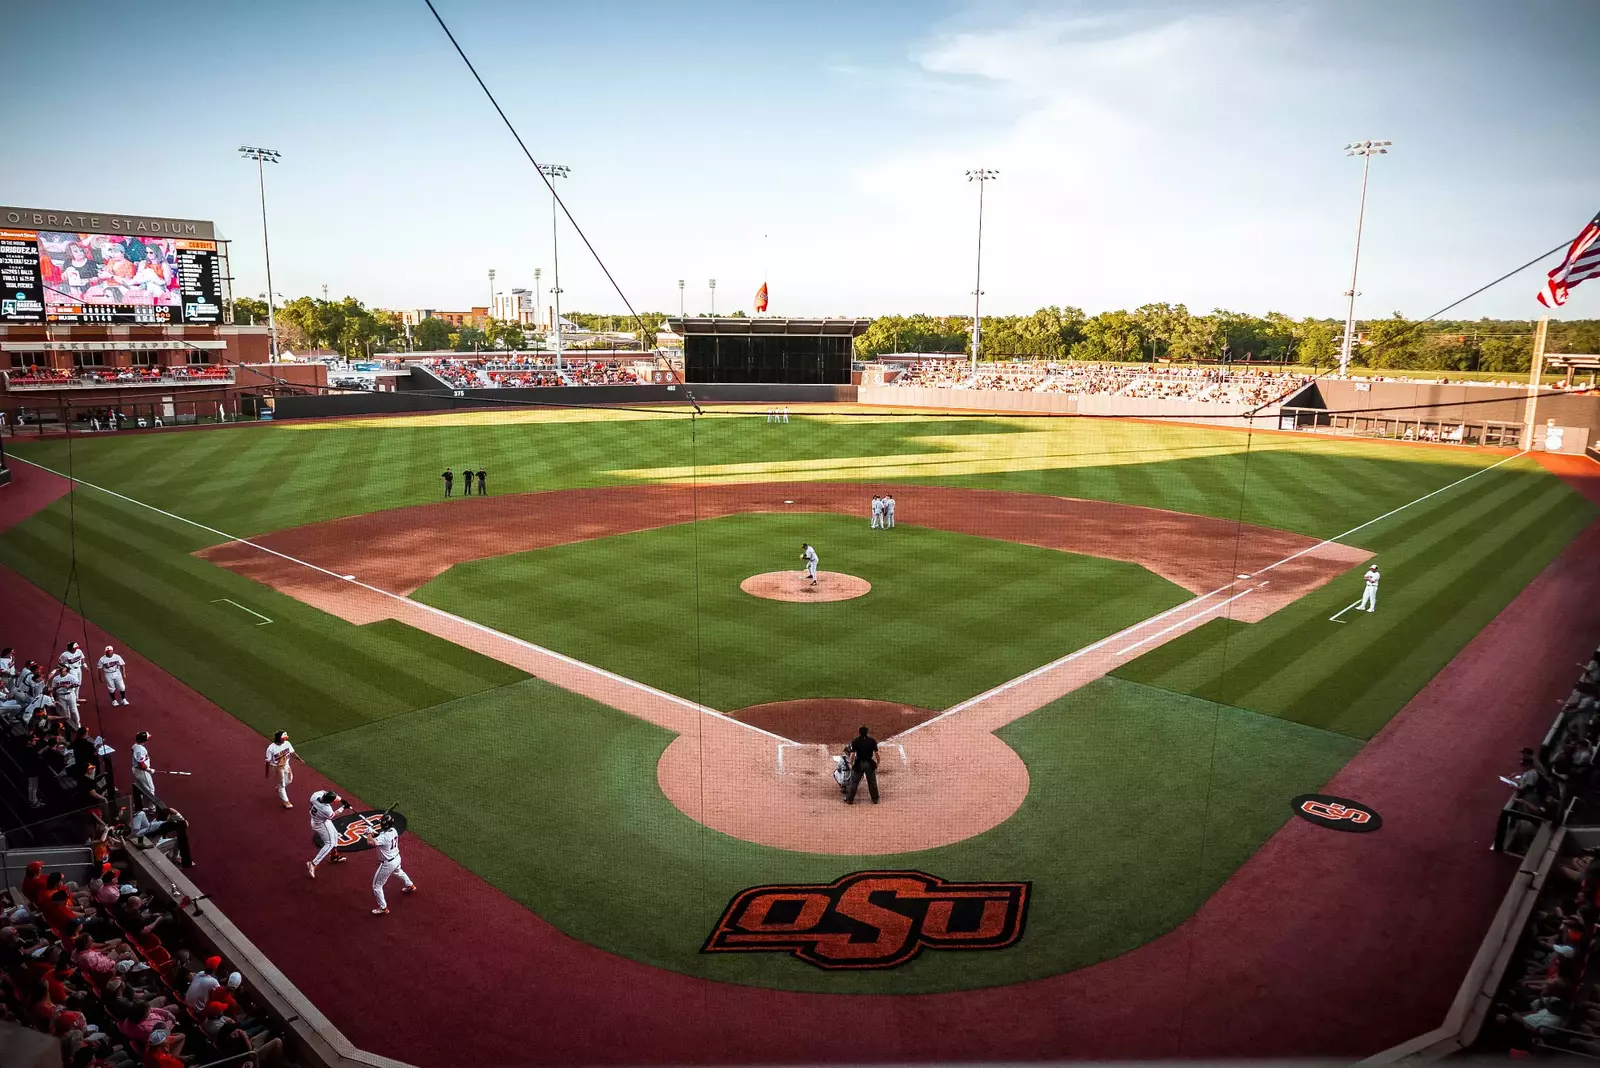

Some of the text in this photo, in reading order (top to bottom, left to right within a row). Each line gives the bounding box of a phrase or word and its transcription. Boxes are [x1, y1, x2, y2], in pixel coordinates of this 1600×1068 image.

[7, 211, 197, 234] O'BRATE STADIUM
[44, 342, 91, 350] MAKE
[704, 871, 1030, 970] OSU
